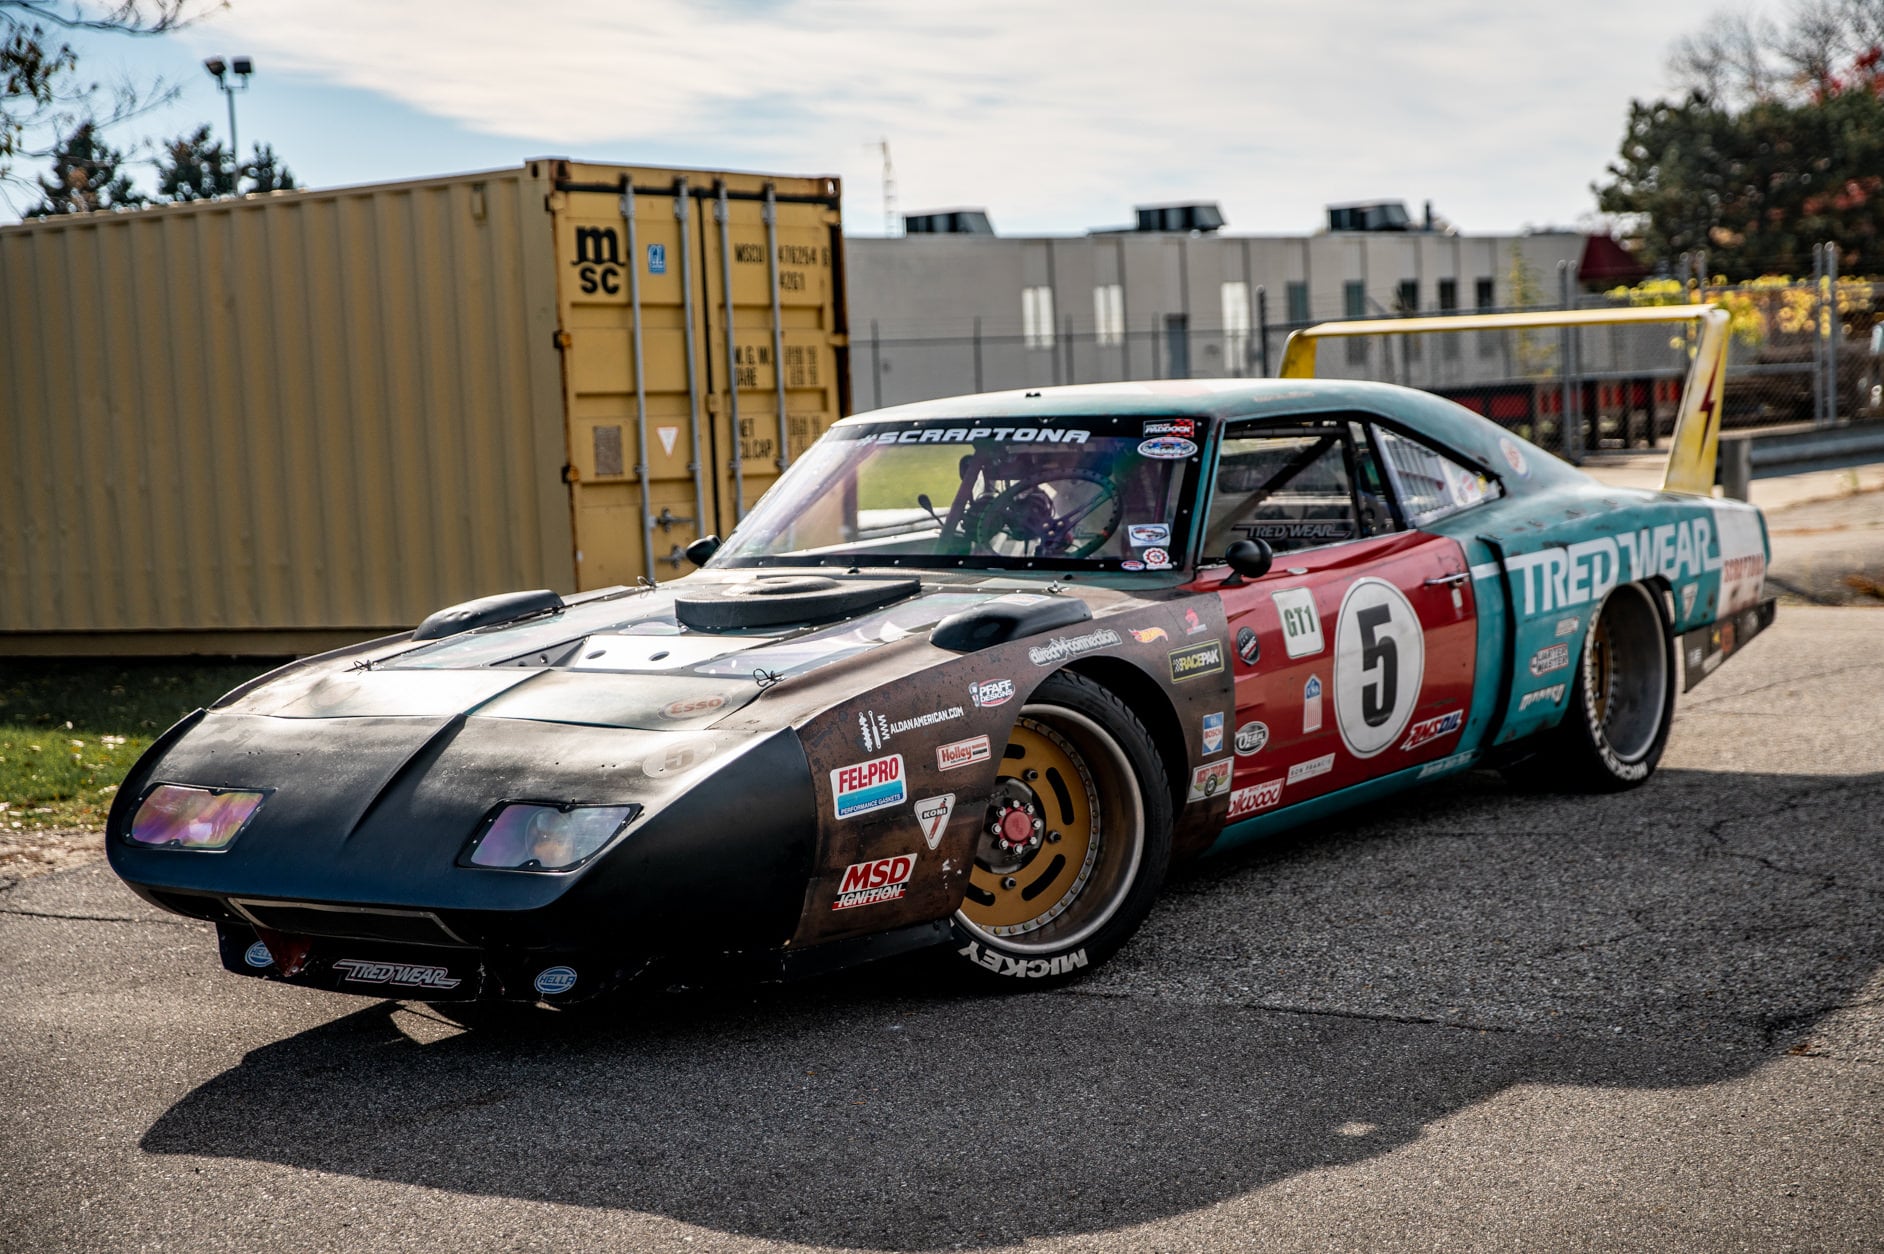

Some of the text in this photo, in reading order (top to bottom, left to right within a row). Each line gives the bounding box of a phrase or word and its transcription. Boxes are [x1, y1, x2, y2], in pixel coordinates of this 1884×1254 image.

[856, 427, 1091, 447] #SCRAPTONA
[1507, 517, 1722, 615] TRED WEAR
[1284, 604, 1316, 638] GT1
[1180, 649, 1220, 672] RACEPAK
[1356, 603, 1398, 727] 5
[980, 680, 1012, 697] PFAFF
[980, 689, 1014, 704] DESIGNS
[941, 744, 972, 763] Holley
[838, 756, 900, 794] FEL-PRO
[840, 793, 901, 815] PERFORMANCE GASKETS
[922, 807, 947, 818] KONI
[841, 857, 911, 893] MSD
[837, 884, 902, 908] IGNITION
[958, 940, 1089, 978] MICKEY
[342, 962, 453, 987] TRED WEAR
[540, 975, 576, 985] HELLA
